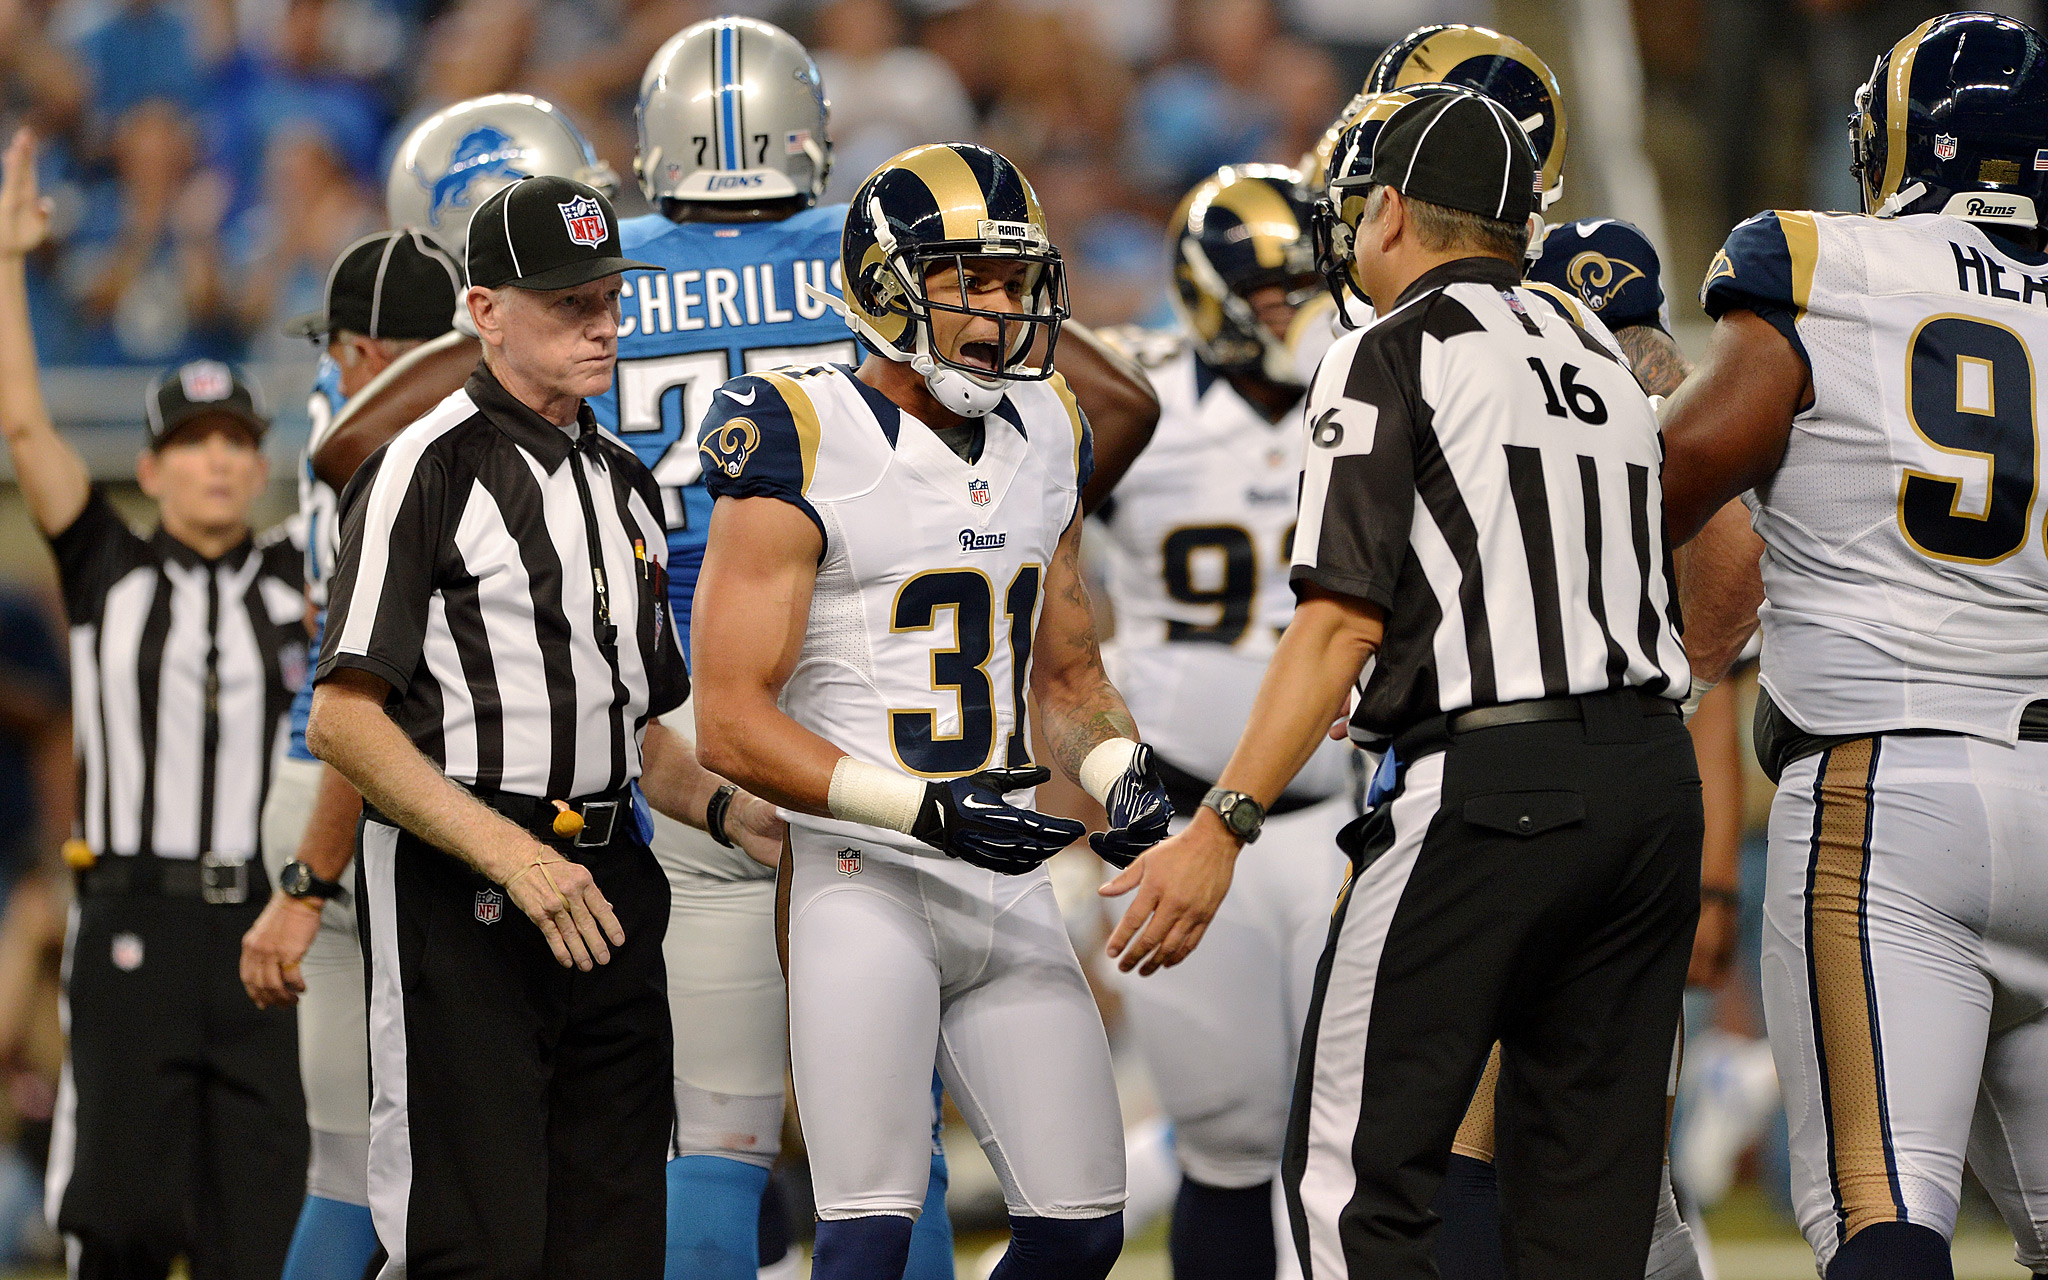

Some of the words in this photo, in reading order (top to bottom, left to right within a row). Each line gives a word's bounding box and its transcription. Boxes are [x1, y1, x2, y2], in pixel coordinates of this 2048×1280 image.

[692, 136, 707, 166] 7
[754, 134, 769, 164] 7
[1937, 144, 1953, 157] NFL
[1966, 198, 2017, 218] Rams
[570, 216, 604, 240] NFL
[997, 224, 1026, 237] RAMS
[1526, 356, 1608, 426] 16
[1310, 407, 1345, 450] 6
[971, 490, 990, 504] NFL
[958, 528, 1007, 552] Rams
[886, 562, 1042, 779] 31
[840, 859, 859, 873] NFL
[478, 904, 499, 920] NFL
